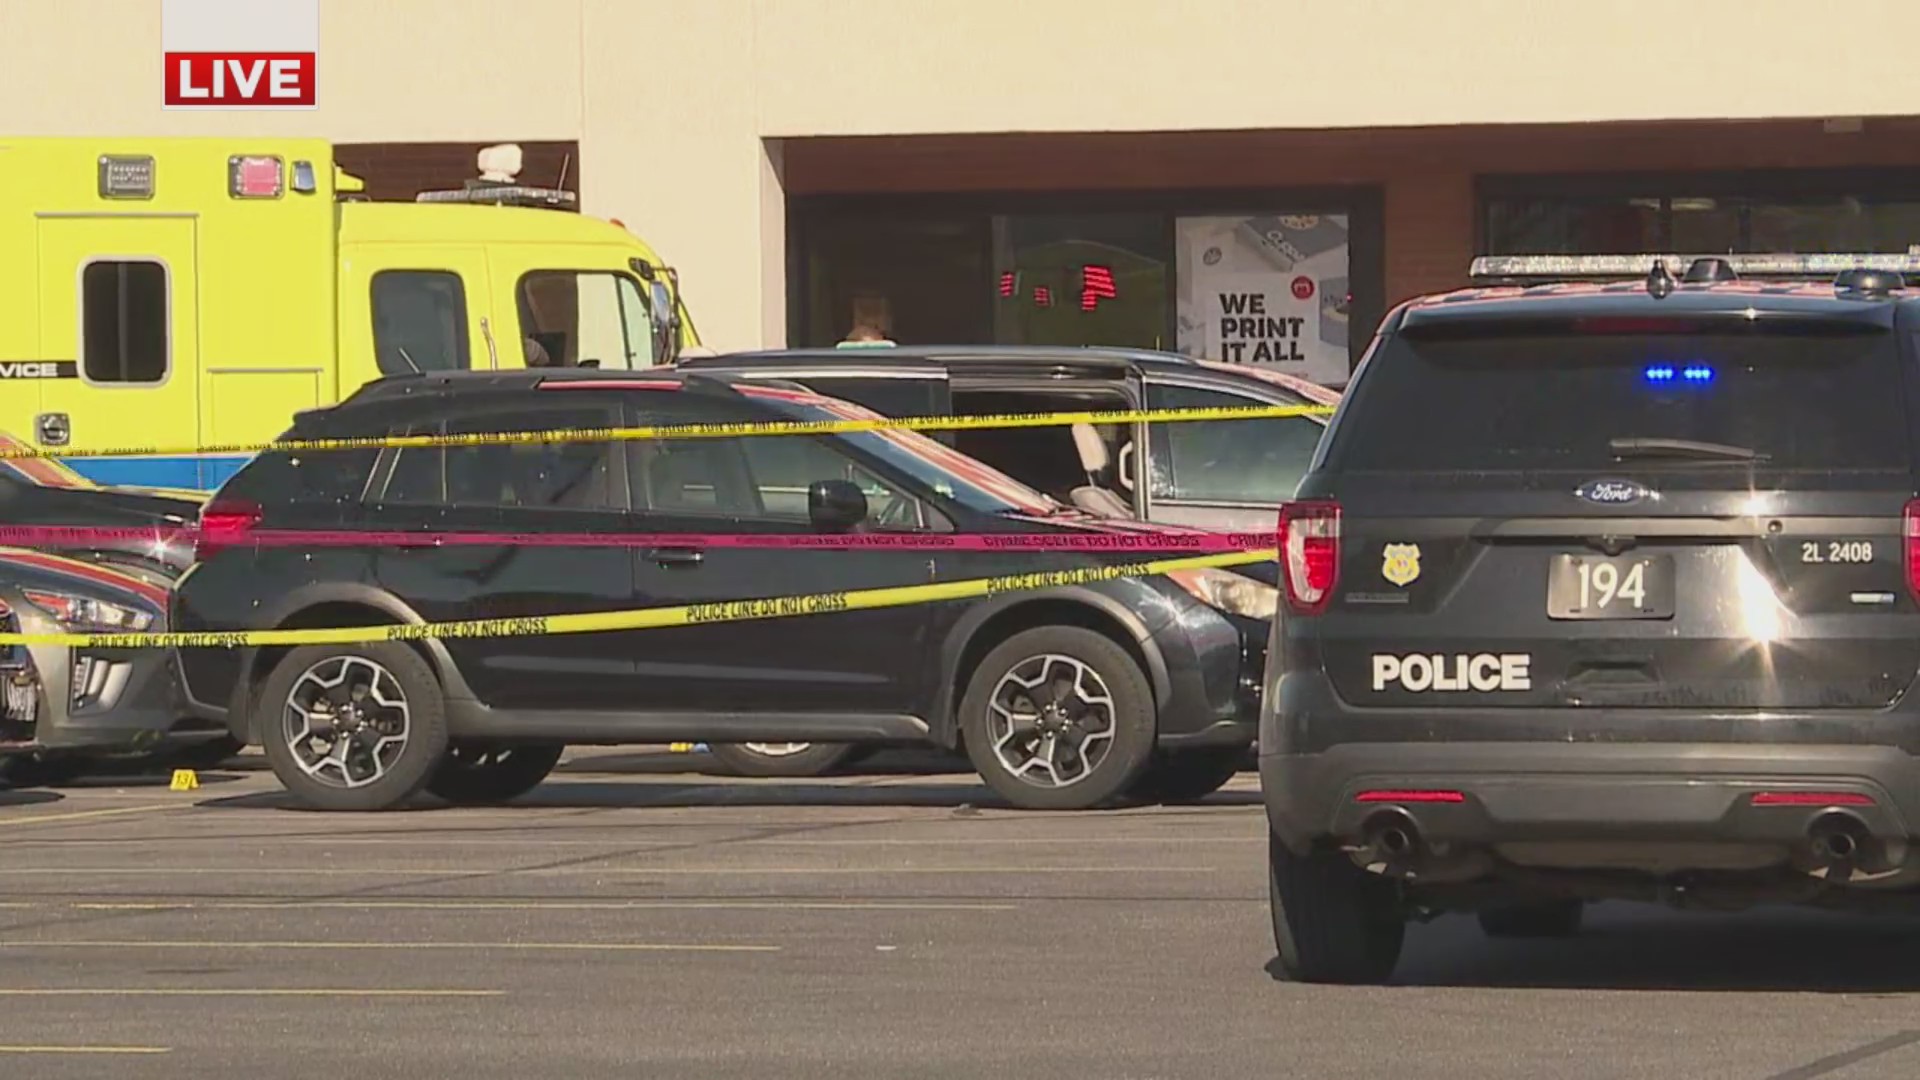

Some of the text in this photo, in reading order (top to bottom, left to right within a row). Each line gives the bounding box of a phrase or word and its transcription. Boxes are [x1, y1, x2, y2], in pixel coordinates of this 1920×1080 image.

[1219, 293, 1265, 315] WE
[1221, 317, 1304, 339] PRINT
[1222, 341, 1305, 363] IT ALL
[0, 363, 58, 378] VICE
[1591, 483, 1633, 501] Ford
[1087, 534, 1109, 547] DO
[1112, 534, 1141, 547] NOT
[1145, 534, 1199, 547] CROSS
[1227, 534, 1276, 547] CRIME
[1802, 541, 1873, 563] 2L 2408
[987, 563, 1150, 592] POLICE LINE DO NOT CROSS
[1578, 562, 1646, 609] 194
[687, 593, 848, 622] POLICE LINE DO NOT CROSS
[89, 632, 249, 648] POLICE LINE DO NOT CROSS
[387, 618, 548, 641] POLICE LINE DO NOT CROSS
[1372, 653, 1531, 692] POLICE
